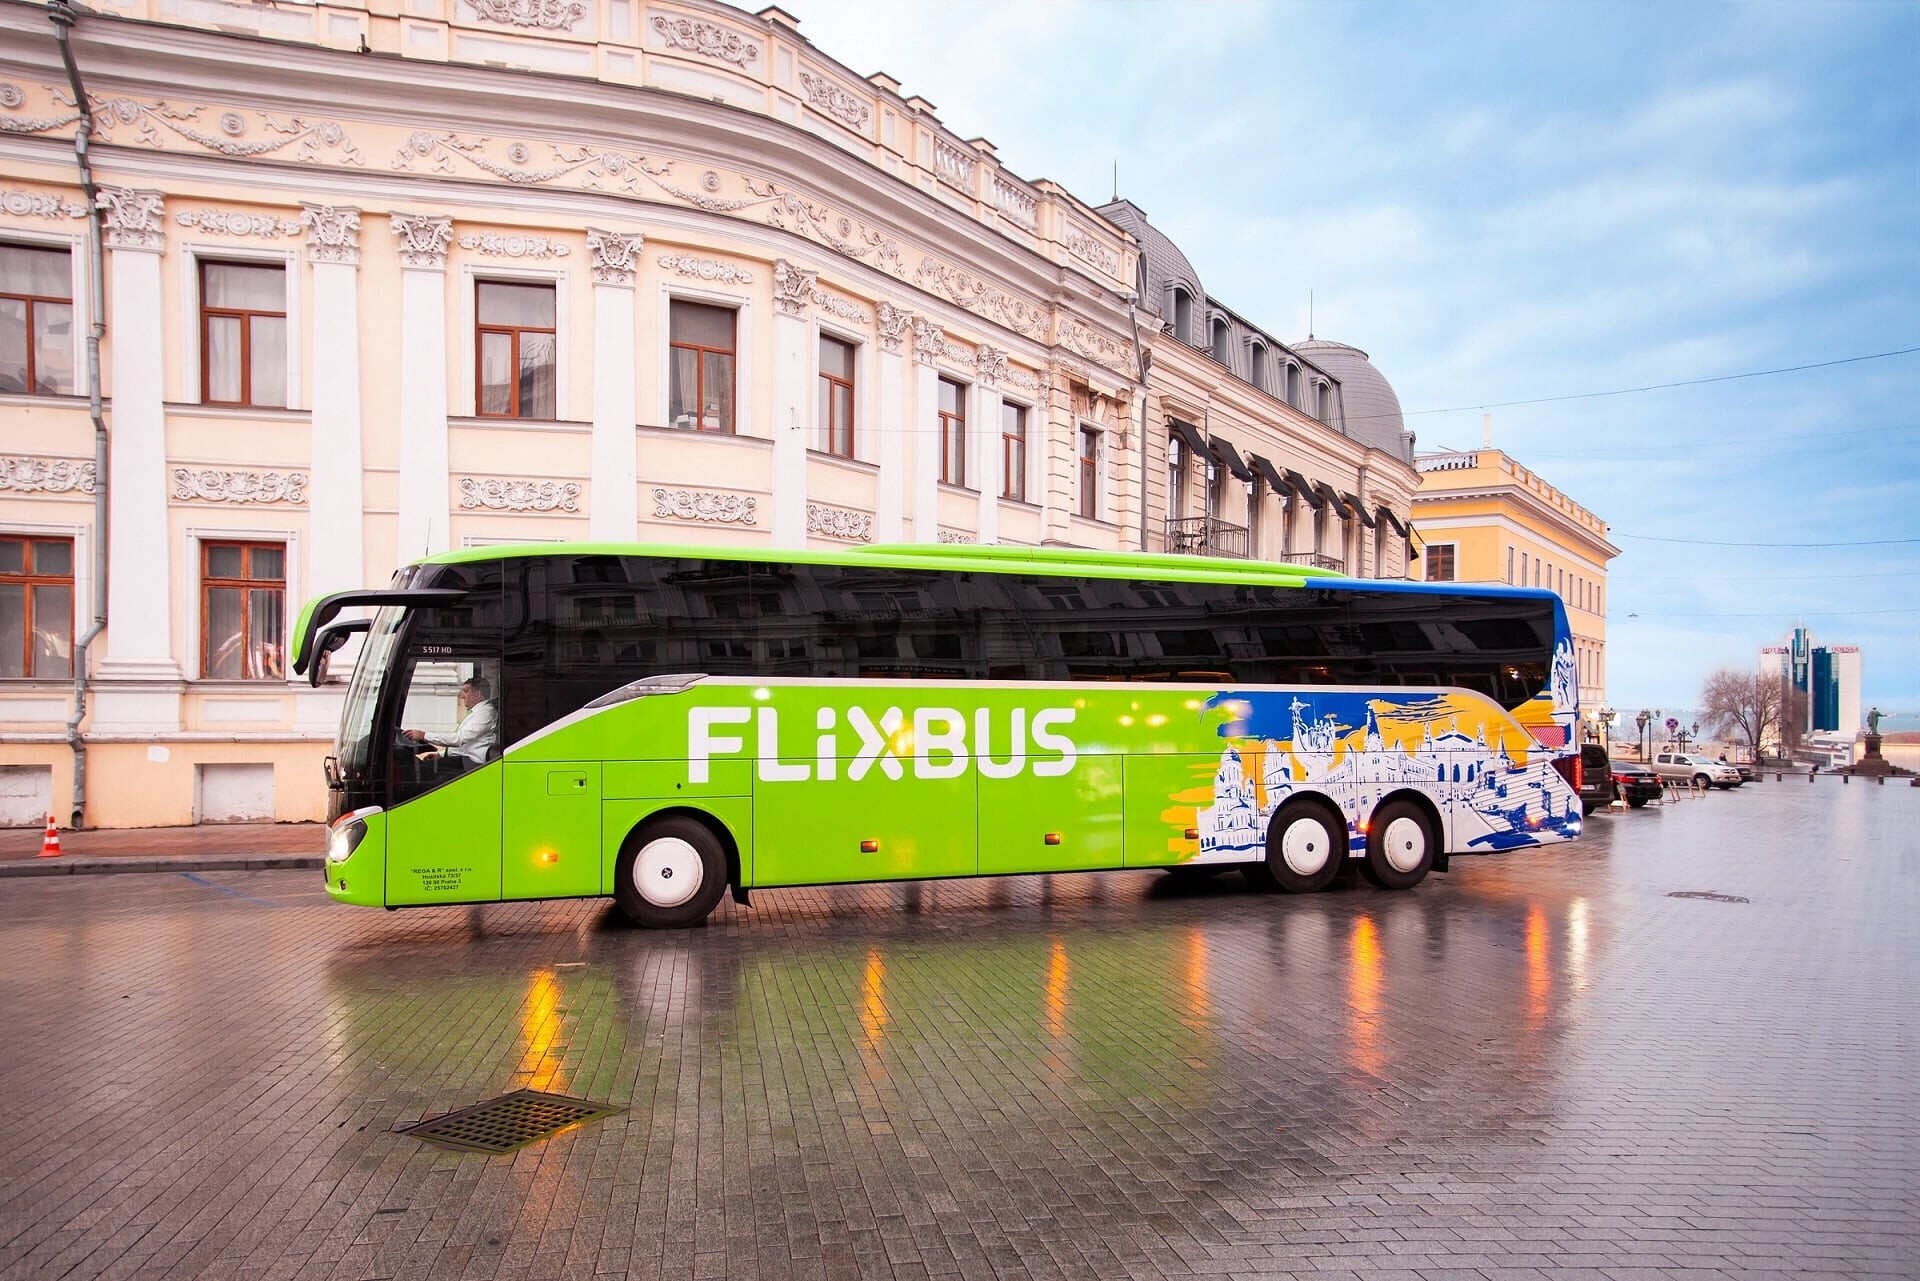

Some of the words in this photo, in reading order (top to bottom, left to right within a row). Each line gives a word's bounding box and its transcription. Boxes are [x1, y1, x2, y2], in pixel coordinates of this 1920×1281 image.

[422, 646, 428, 654] S
[428, 646, 440, 654] 517
[441, 646, 452, 654] HD
[1831, 646, 1859, 654] ODESSA
